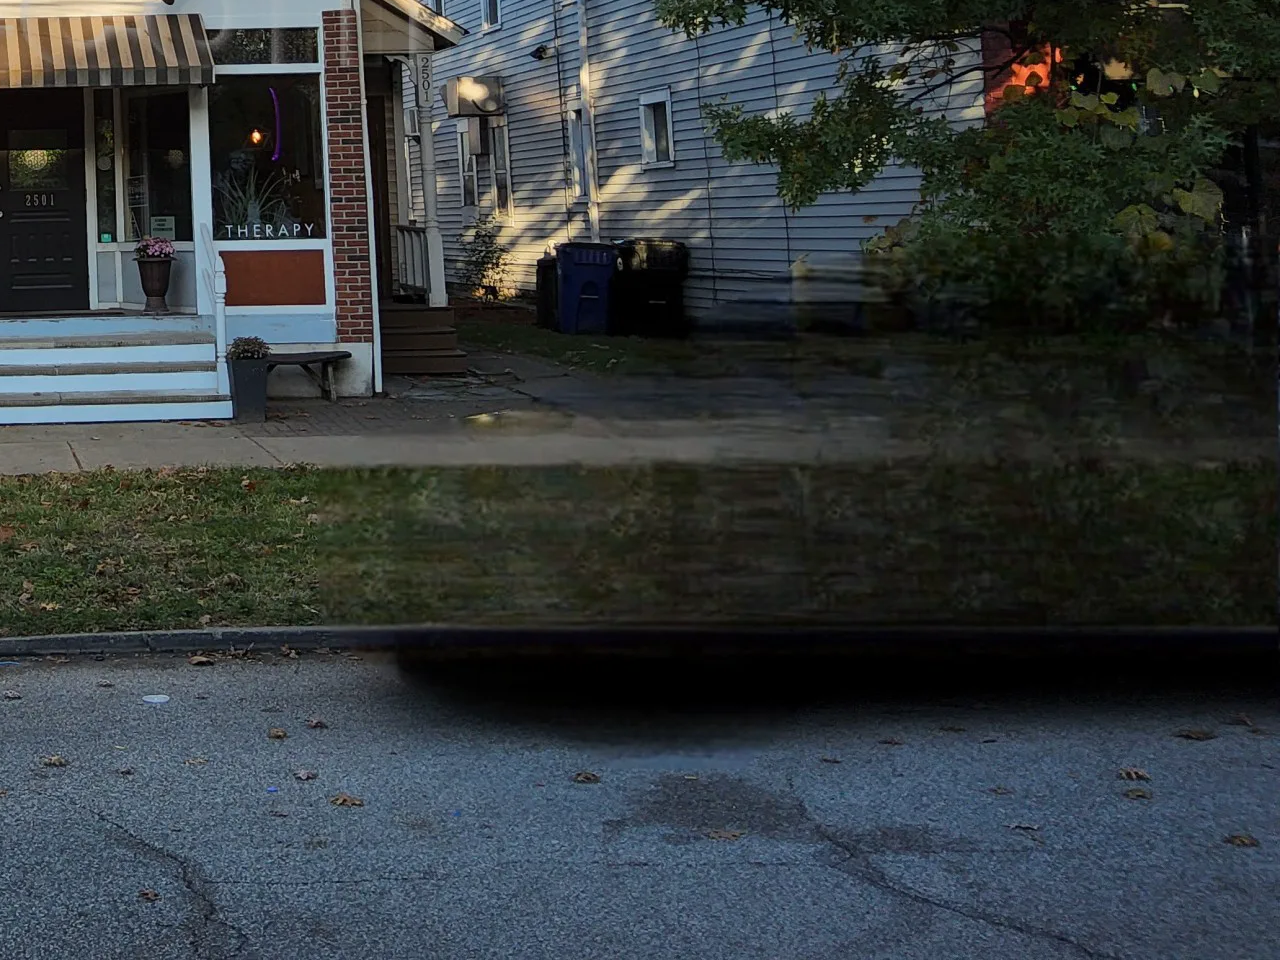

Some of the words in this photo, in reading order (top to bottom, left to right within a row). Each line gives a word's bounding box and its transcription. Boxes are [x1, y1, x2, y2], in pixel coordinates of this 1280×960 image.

[421, 56, 431, 102] 2501
[25, 194, 54, 206] 2501
[225, 223, 314, 238] THERAPY
